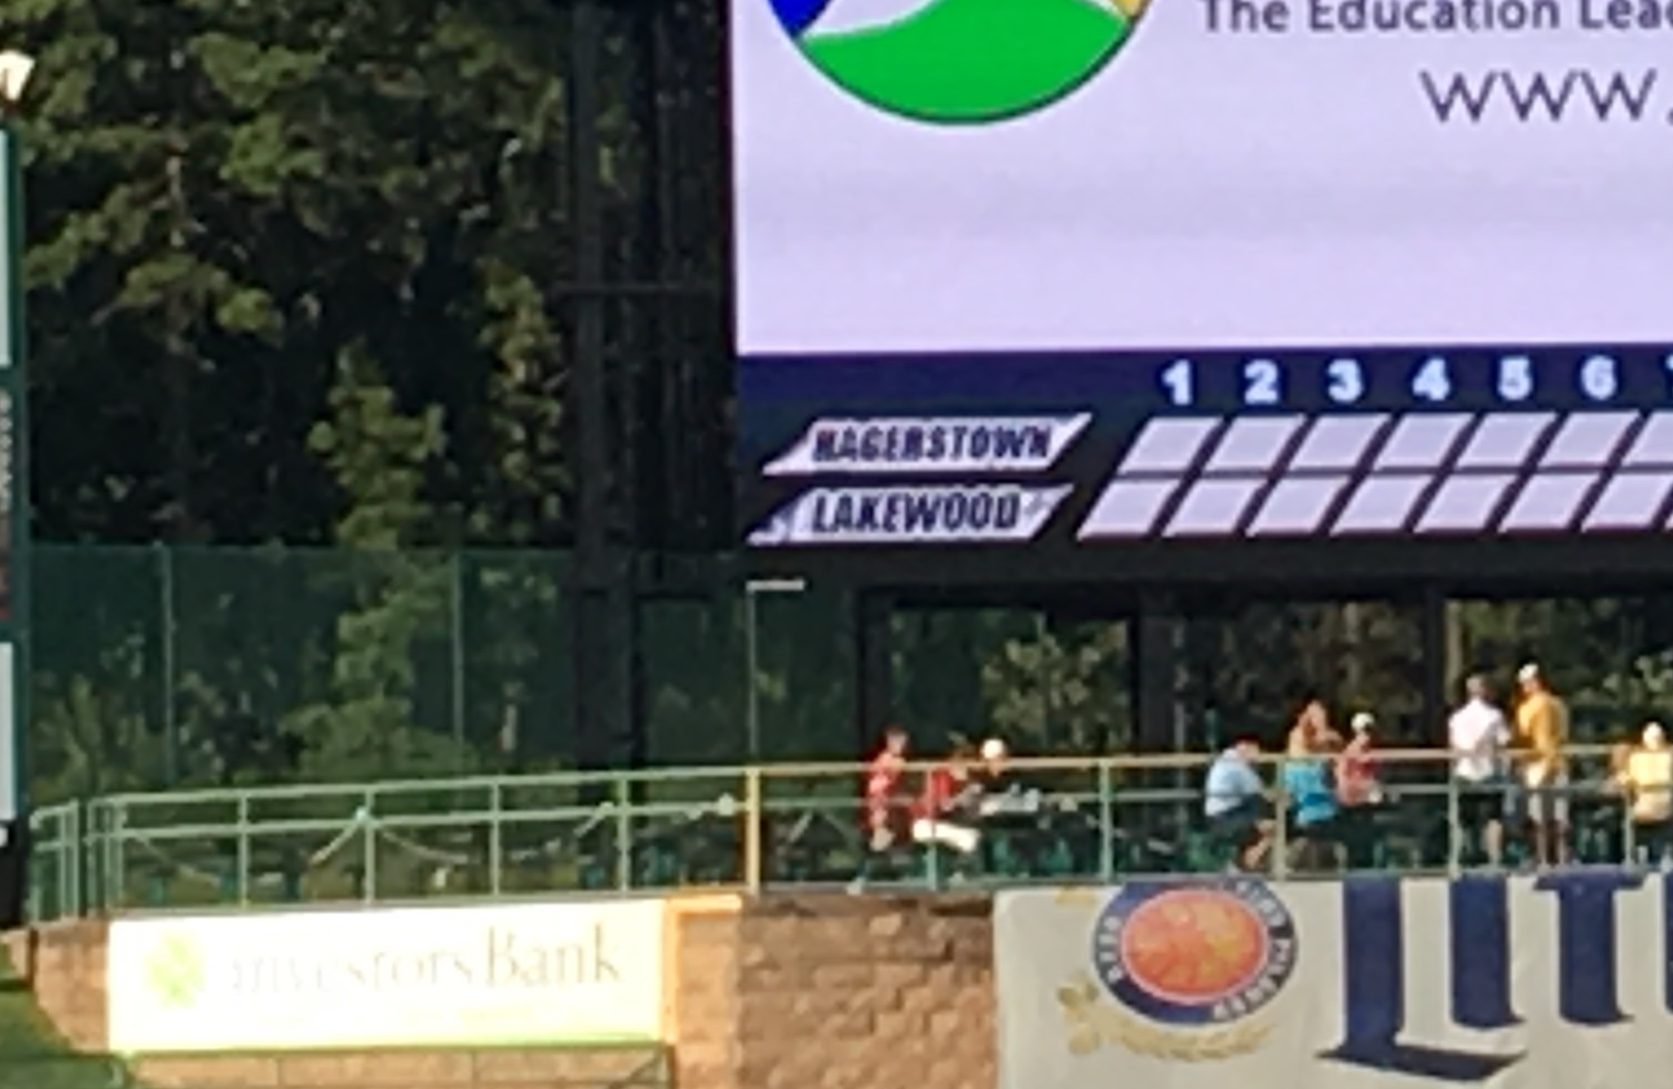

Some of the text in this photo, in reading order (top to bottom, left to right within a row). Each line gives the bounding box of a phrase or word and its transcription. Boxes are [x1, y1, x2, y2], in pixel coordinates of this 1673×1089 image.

[1161, 359, 1191, 405] 1
[1244, 359, 1279, 405] 2
[1328, 359, 1363, 403] 3
[1412, 357, 1450, 401] 4
[1498, 356, 1532, 401] 5
[1581, 355, 1617, 401] 6
[812, 425, 1052, 462] HAGERSTOWN
[811, 492, 1022, 533] LAKEWOOD
